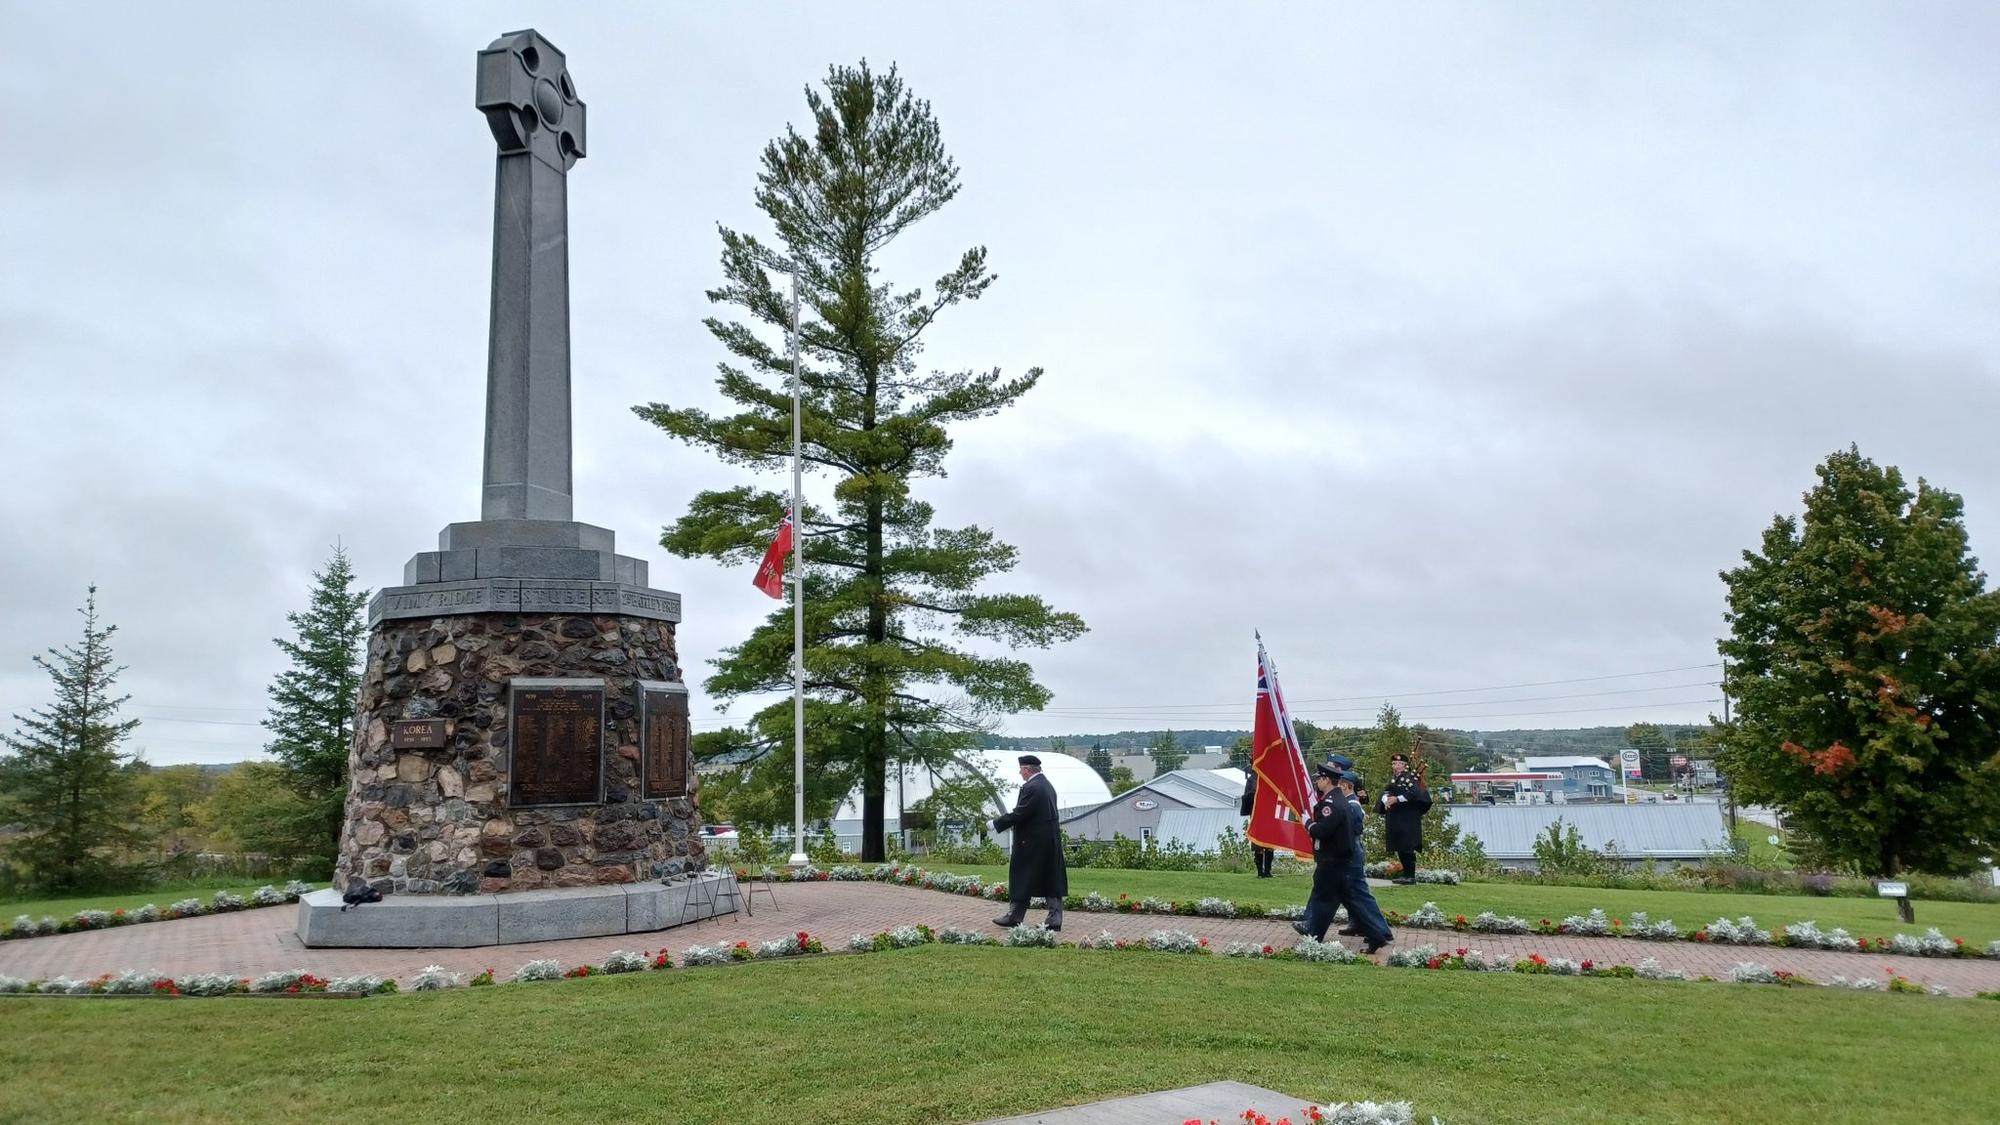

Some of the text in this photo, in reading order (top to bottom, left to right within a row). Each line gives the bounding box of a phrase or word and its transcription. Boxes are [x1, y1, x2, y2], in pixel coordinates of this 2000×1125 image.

[391, 591, 483, 610] VIMY RIDGE
[495, 589, 614, 605] FESTUBERT
[403, 725, 432, 734] KOREA
